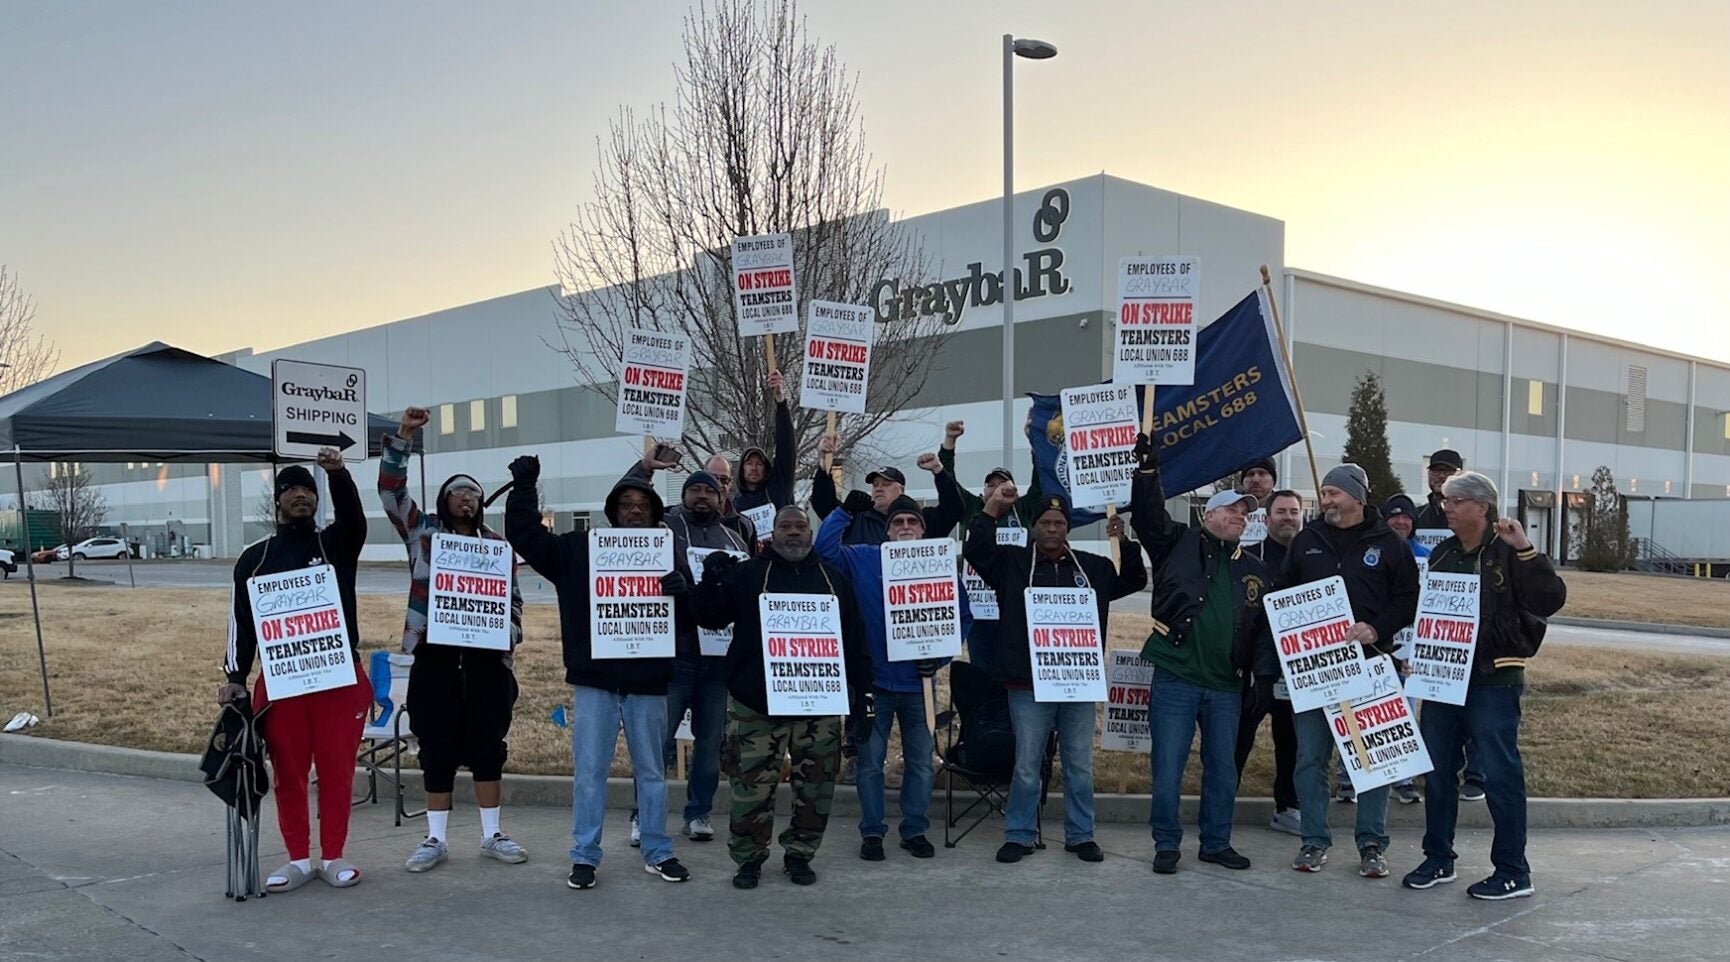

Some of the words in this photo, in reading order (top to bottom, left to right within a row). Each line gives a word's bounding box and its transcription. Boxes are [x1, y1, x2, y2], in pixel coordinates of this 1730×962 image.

[738, 240, 775, 252] EMPLOYEES
[777, 239, 785, 248] OF
[1127, 263, 1176, 275] EMPLOYEES
[1180, 263, 1191, 274] OF
[738, 273, 753, 290] ON
[754, 269, 791, 289] STRIKE
[740, 290, 792, 307] TEAMSTERS
[742, 308, 761, 319] LOCAL
[762, 306, 780, 317] UNION
[781, 304, 793, 315] 688
[816, 307, 856, 321] EMPLOYEES
[858, 312, 867, 322] OF
[1121, 303, 1140, 324] ON
[1142, 303, 1192, 324] STRIKE
[632, 334, 672, 349] EMPLOYEES
[675, 341, 684, 351] OF
[1120, 329, 1190, 345] TEAMSTERS
[809, 340, 825, 359] ON
[826, 342, 867, 364] STRIKE
[1120, 349, 1145, 361] LOCAL
[1146, 349, 1171, 361] UNION
[1173, 349, 1188, 361] 688
[625, 366, 641, 385] ON
[642, 369, 684, 391] STRIKE
[807, 362, 864, 381] TEAMSTERS
[282, 382, 358, 402] GraybaR
[807, 378, 827, 390] LOCAL
[828, 380, 849, 393] UNION
[849, 383, 862, 394] 688
[623, 388, 681, 408] TEAMSTERS
[1069, 390, 1115, 406] EMPLOYEES
[1118, 389, 1128, 400] OF
[1152, 366, 1262, 432] EAMSTERS
[1220, 391, 1258, 418] 688
[286, 406, 357, 425] SHIPPING
[622, 404, 643, 416] LOCAL
[644, 406, 665, 419] UNION
[666, 409, 678, 420] 688
[1070, 430, 1088, 452] ON
[1090, 424, 1137, 449] STRIKE
[1073, 449, 1138, 471] TEAMSTERS
[1076, 472, 1099, 486] LOCAL
[1100, 468, 1124, 483] UNION
[599, 536, 649, 548] EMPLOYEES
[654, 536, 664, 548] OF
[1012, 533, 1021, 541] OF
[441, 540, 489, 554] EMPLOYEES
[493, 546, 504, 556] OF
[890, 545, 935, 559] EMPLOYEES
[938, 545, 948, 556] OF
[257, 575, 312, 595] EMPLOYEES
[314, 572, 328, 584] OF
[435, 572, 454, 592] ON
[457, 575, 506, 598] STRIKE
[596, 576, 614, 598] ON
[618, 576, 664, 597] STRIK
[889, 585, 906, 605] ON
[908, 581, 954, 604] STRIKE
[1427, 579, 1467, 592] EMPLOYEES
[1468, 582, 1478, 594] OF
[435, 595, 505, 616] TEAMSTERS
[768, 601, 817, 612] EMPLOYEES
[820, 602, 831, 612] OF
[1033, 594, 1076, 604] EMPLOYEES
[1079, 595, 1089, 604] OF
[1272, 587, 1323, 611] EMPLOYEES
[1324, 584, 1337, 597] OF
[597, 602, 669, 619] TEAMSTERS
[891, 605, 955, 625] TEAMSTERS
[261, 618, 283, 642] ON
[284, 608, 340, 637] STRIKE
[435, 612, 460, 625] LOCAL
[462, 614, 487, 628] UNION
[489, 618, 504, 629] 688
[598, 622, 623, 635] LOCAL
[625, 622, 651, 634] UNION
[653, 622, 668, 634] 688
[892, 626, 915, 640] LOCAL
[916, 624, 940, 638] UNION
[941, 623, 955, 636] 688
[1033, 628, 1050, 647] ON
[1052, 629, 1097, 647] STRIKE
[1417, 617, 1433, 639] ON
[1433, 619, 1475, 644] STRIKE
[266, 633, 344, 662] TEAMSTERS
[768, 637, 787, 657] ON
[789, 638, 839, 657] STRIKE
[1279, 633, 1302, 657] ON
[1413, 643, 1469, 665] TEAMSTERS
[270, 660, 298, 677] LOCAL
[298, 655, 328, 672] UNION
[328, 651, 346, 666] 688
[1036, 652, 1099, 666] TEAMSTERS
[1287, 644, 1359, 676] TEAMSTERS
[1373, 662, 1387, 675] OF
[770, 663, 840, 677] TEAMSTERS
[1038, 669, 1061, 680] LOCAL
[1061, 669, 1085, 680] UNION
[1085, 669, 1100, 680] 688
[1292, 673, 1319, 690] LOCAL
[1318, 666, 1345, 684] UNION
[1344, 662, 1362, 677] 688
[1411, 662, 1431, 676] LOCAL
[1431, 664, 1452, 679] UNION
[1452, 667, 1465, 681] 688
[772, 680, 798, 692] LOCAL
[799, 681, 824, 692] UNION
[825, 681, 841, 692] 688
[1109, 686, 1125, 704] ON
[1127, 688, 1149, 705] STR
[1109, 708, 1149, 721] TEAMST
[1353, 697, 1408, 731] STRIKE
[1107, 722, 1128, 733] LOCAL
[1350, 752, 1377, 771] LOAL
[1375, 744, 1403, 763] UNION
[1401, 739, 1420, 755] 688
